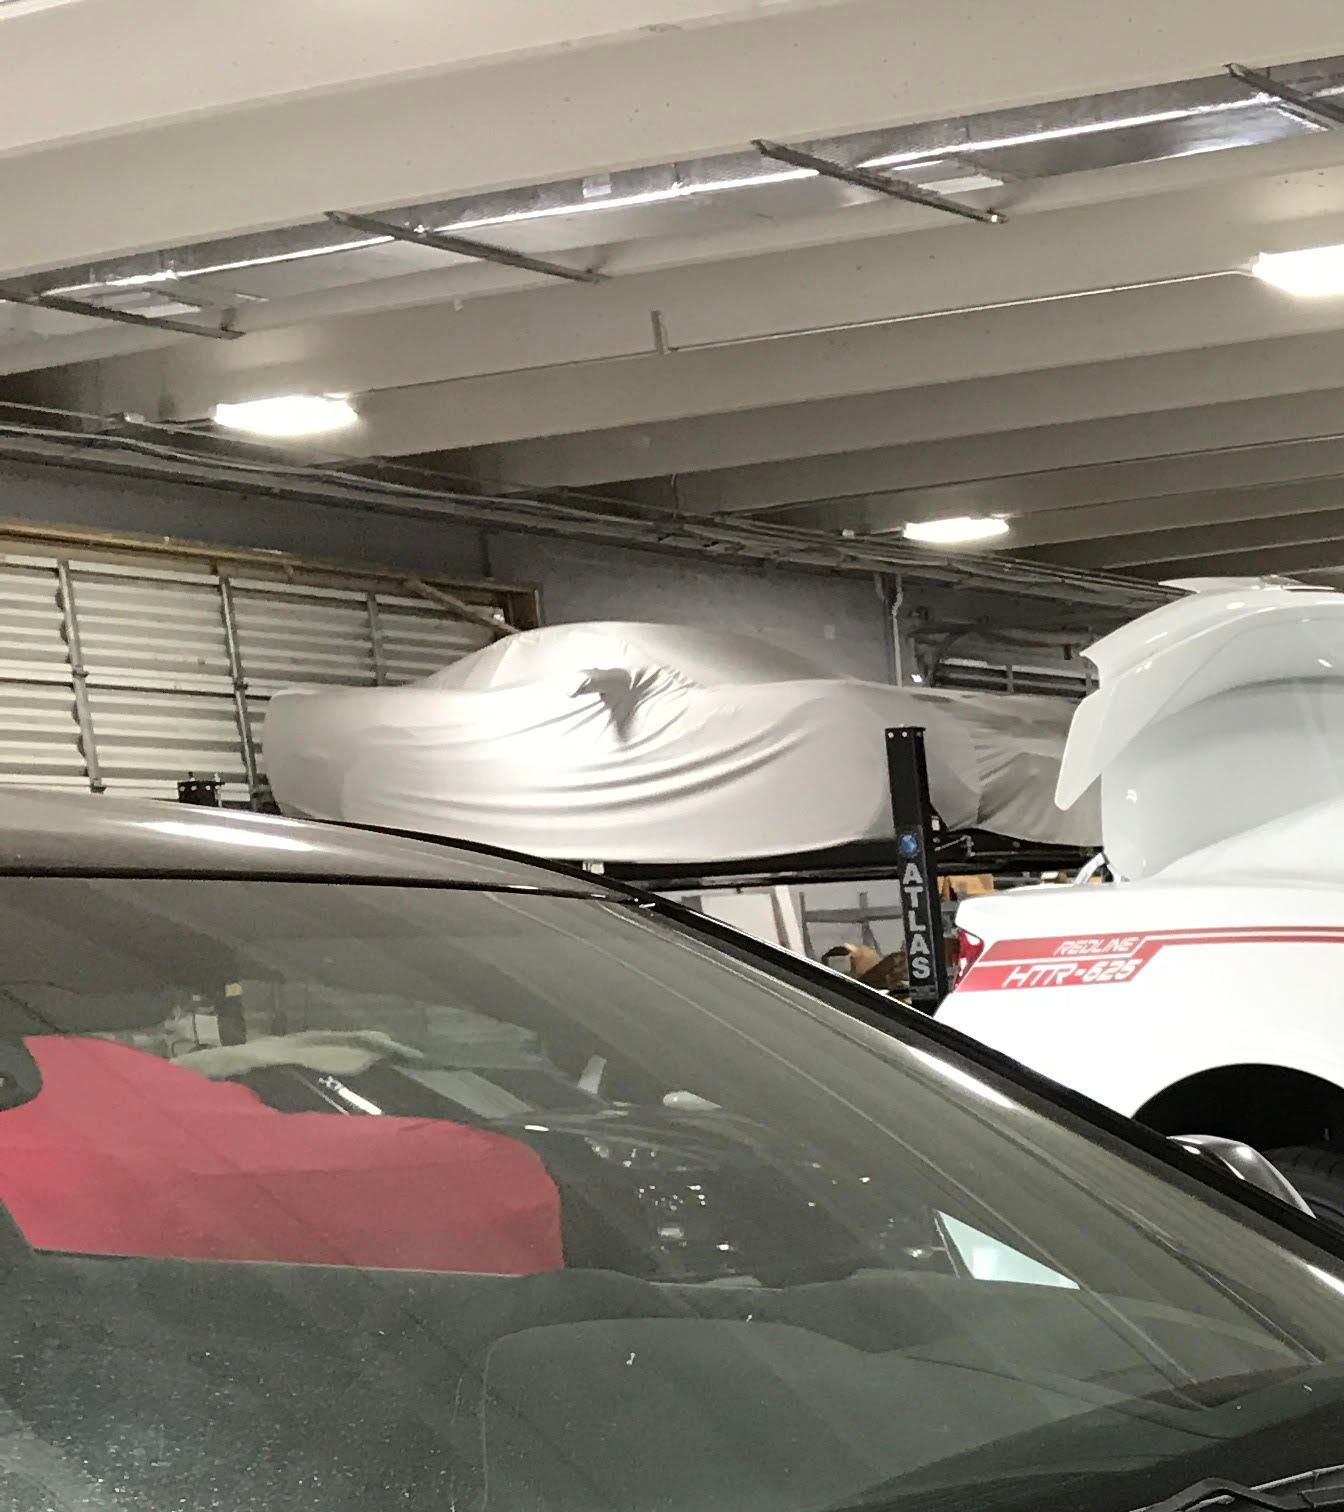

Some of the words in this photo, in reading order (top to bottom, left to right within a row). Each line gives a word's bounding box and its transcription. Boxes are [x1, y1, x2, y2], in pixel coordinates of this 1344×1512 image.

[902, 862, 931, 979] ATLAS
[1054, 937, 1139, 956] REDLINE
[1002, 958, 1144, 988] HTR-625
